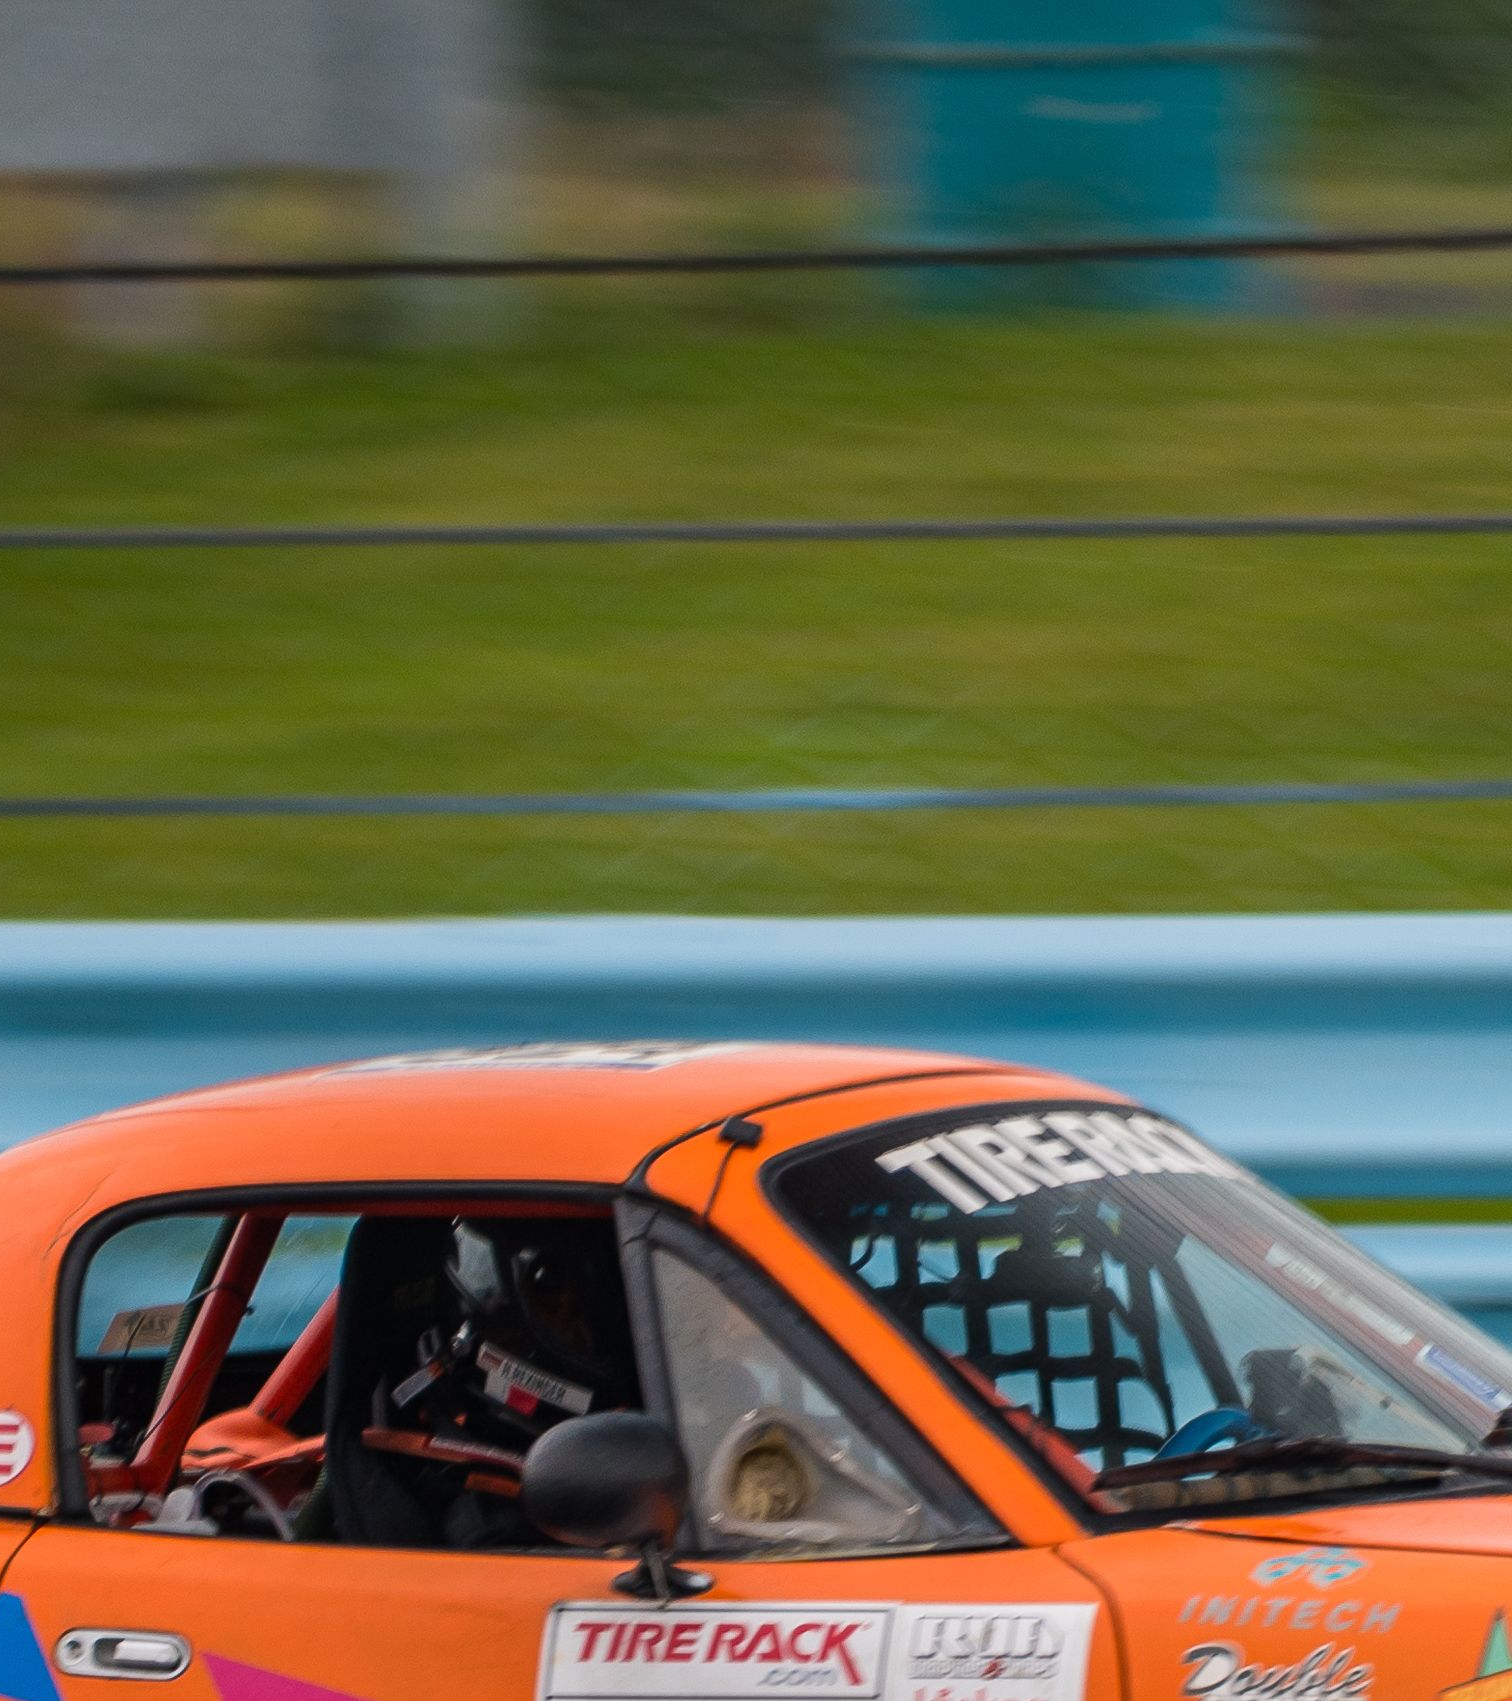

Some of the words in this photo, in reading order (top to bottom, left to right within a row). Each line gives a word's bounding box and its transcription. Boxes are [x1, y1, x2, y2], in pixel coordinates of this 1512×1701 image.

[1177, 1594, 1402, 1634] INITECH
[756, 1667, 838, 1688] .com
[1180, 1639, 1376, 1698] Double
